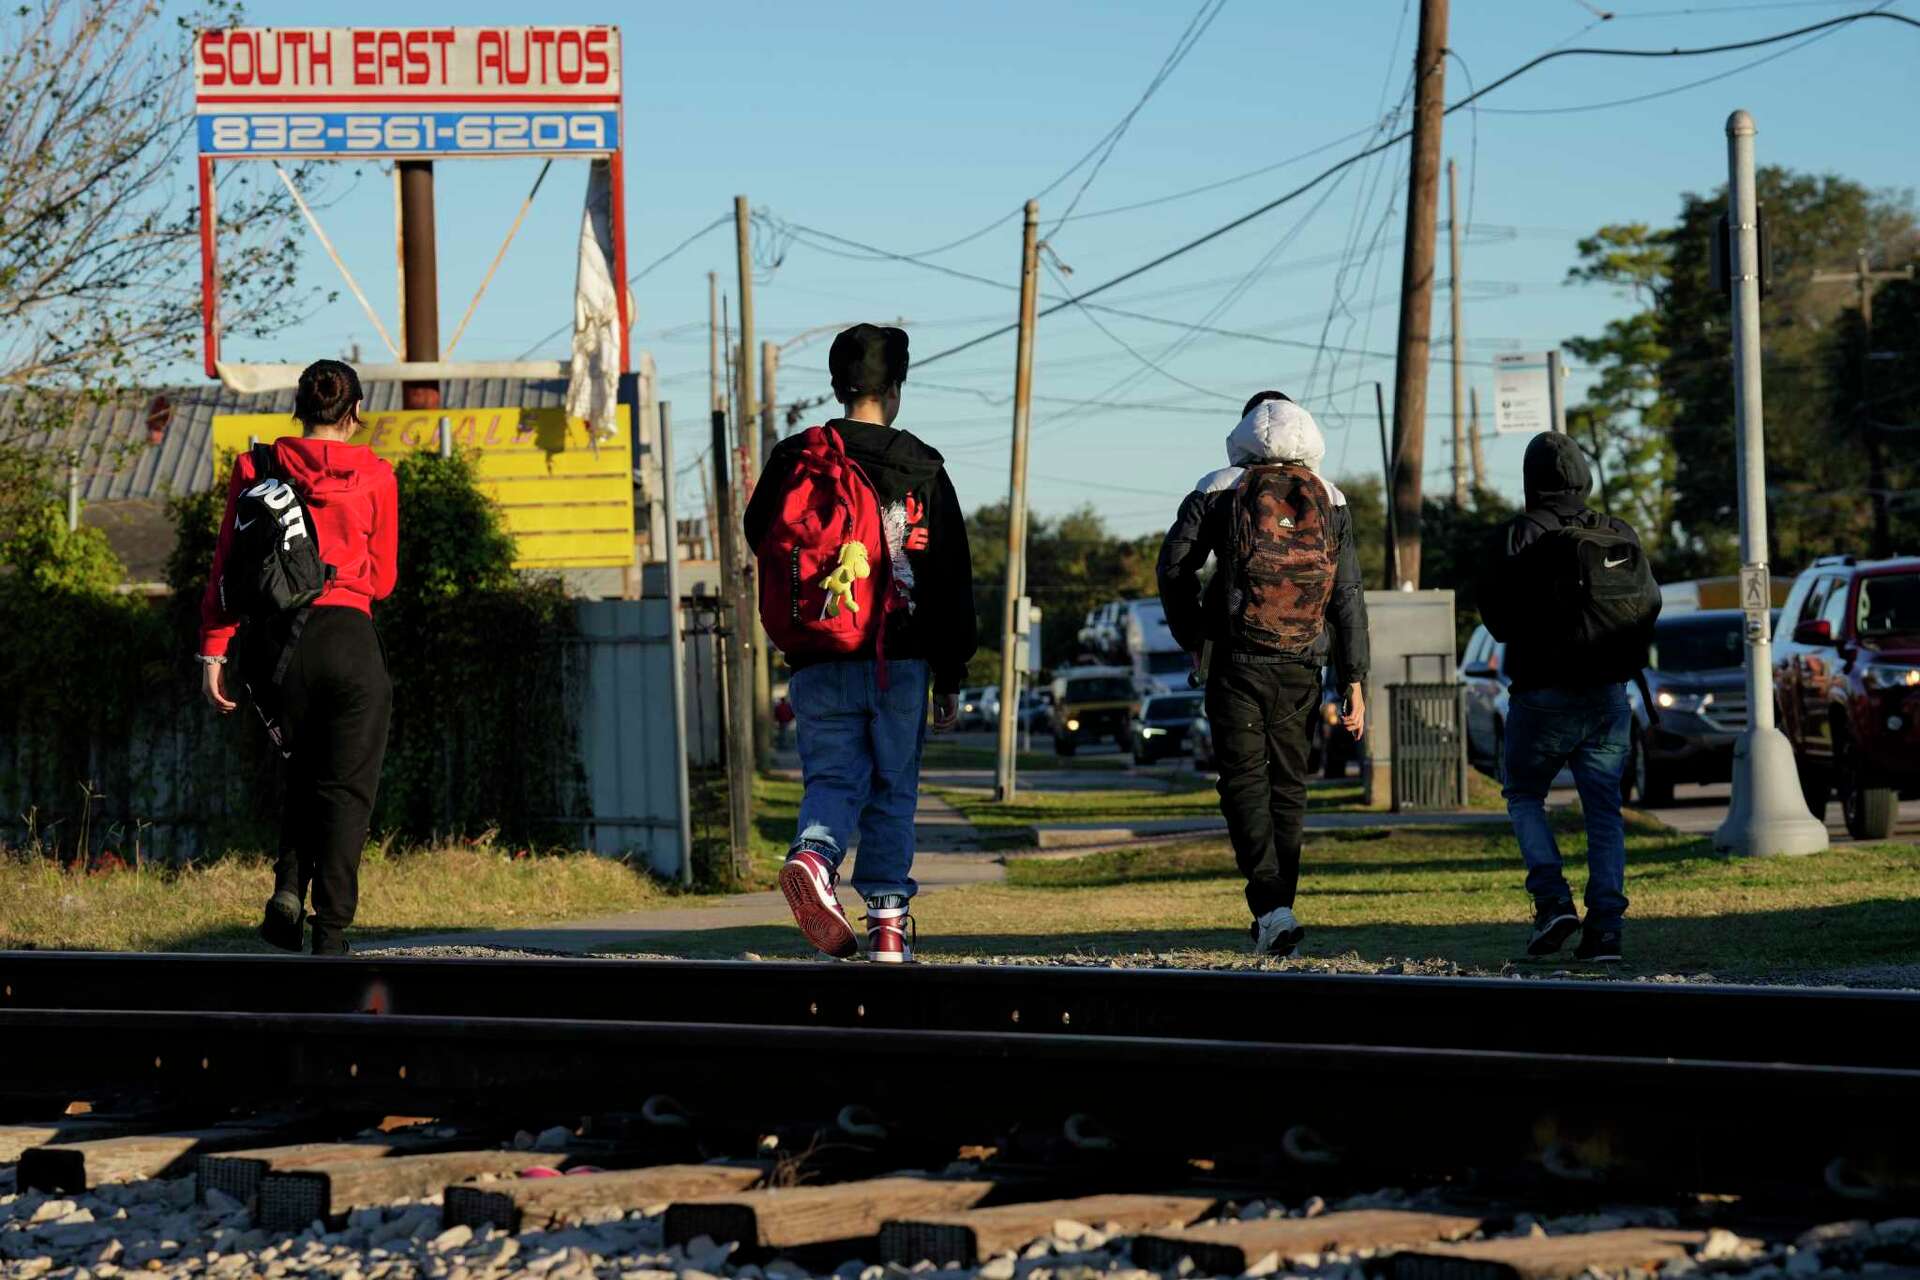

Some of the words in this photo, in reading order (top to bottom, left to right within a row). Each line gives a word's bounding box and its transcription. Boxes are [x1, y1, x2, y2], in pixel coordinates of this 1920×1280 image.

[201, 31, 332, 86] SOUTH
[353, 31, 456, 86] EAST
[477, 30, 610, 86] AUTOS
[211, 115, 606, 150] 832-561-6209
